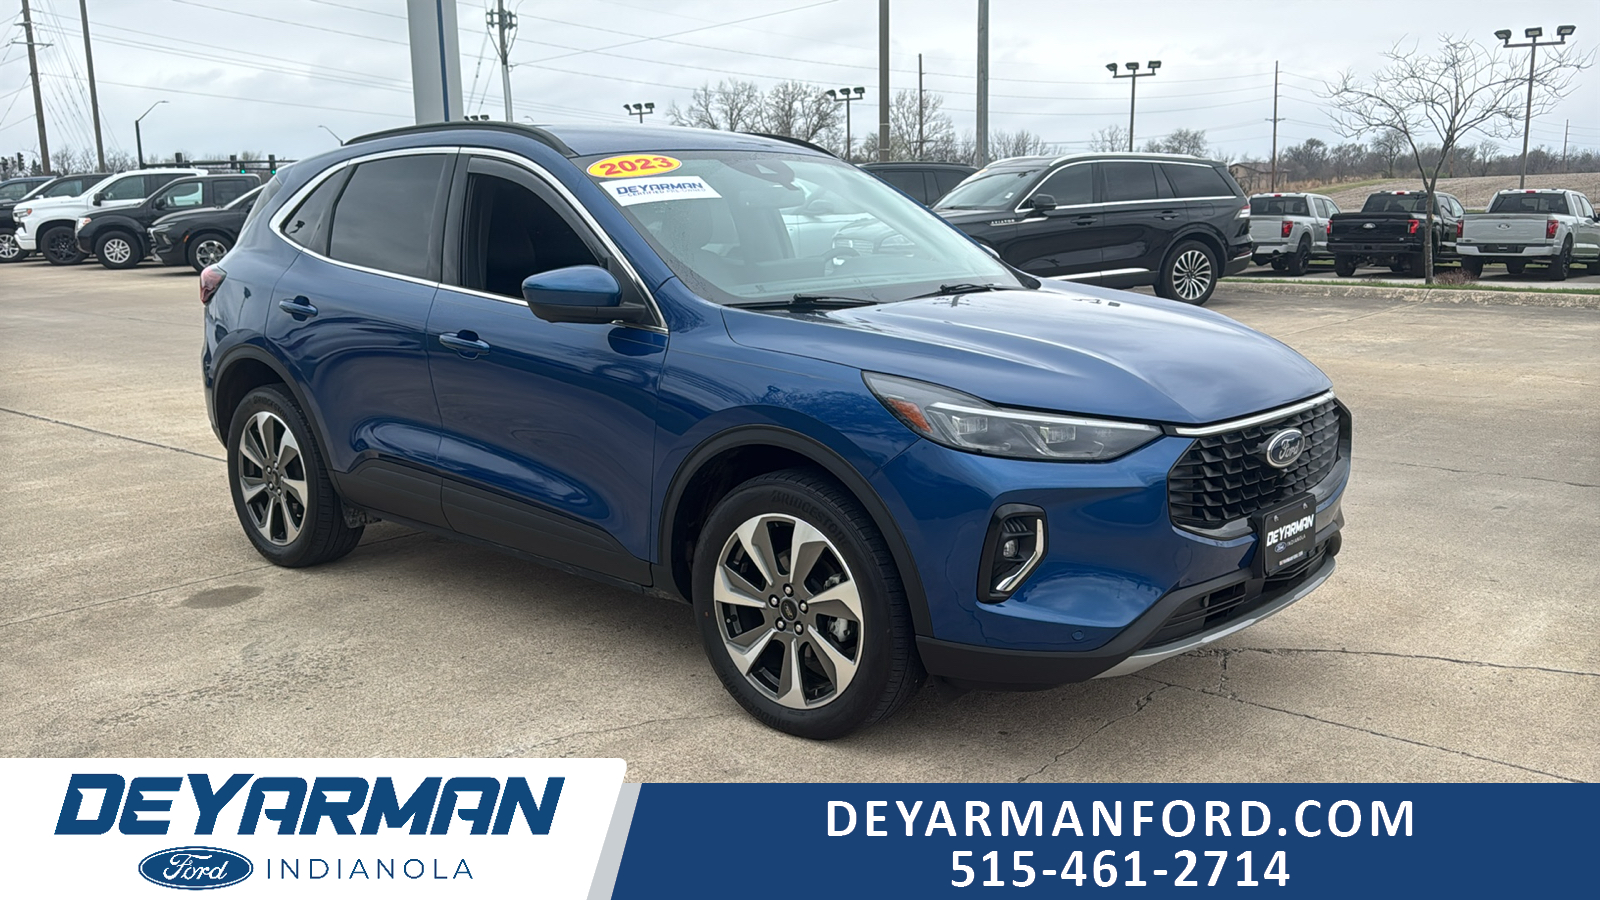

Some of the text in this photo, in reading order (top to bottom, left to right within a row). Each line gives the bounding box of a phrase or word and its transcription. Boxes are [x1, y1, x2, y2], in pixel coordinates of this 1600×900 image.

[599, 157, 675, 176] 2023
[616, 182, 704, 195] DEYARMAN
[628, 189, 665, 197] CERTIFIED
[1266, 513, 1315, 547] DEYARMAN
